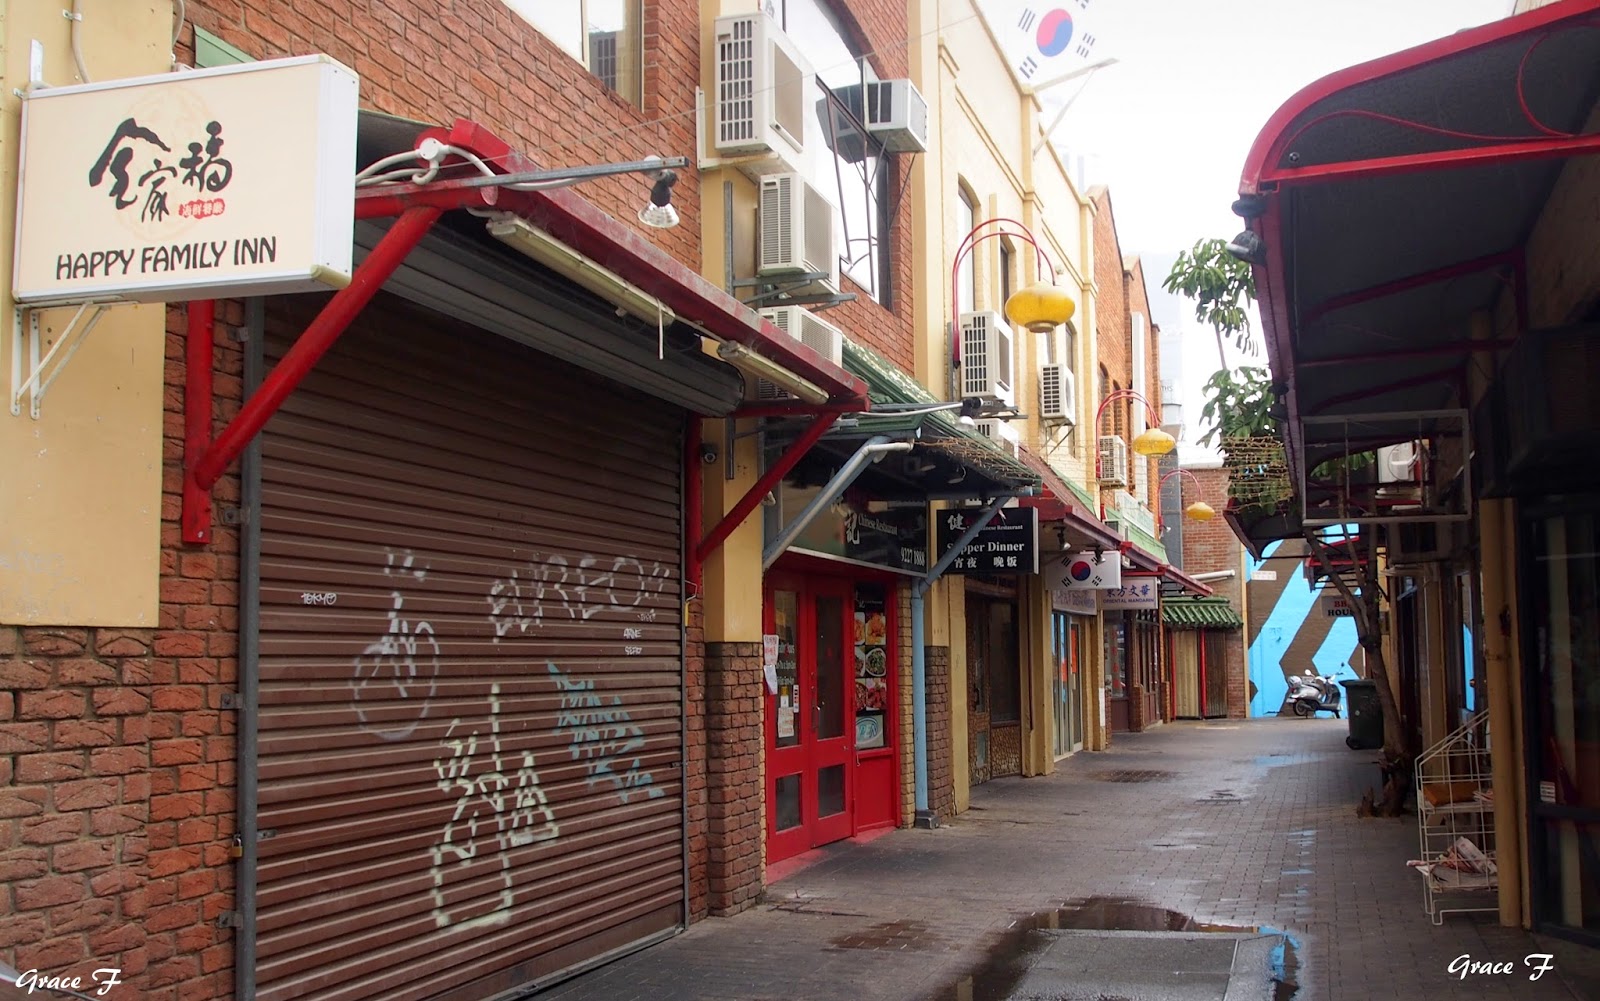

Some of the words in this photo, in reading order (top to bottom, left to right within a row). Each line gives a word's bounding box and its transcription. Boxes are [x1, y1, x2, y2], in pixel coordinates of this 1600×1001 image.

[56, 248, 135, 280] HAPPY
[141, 241, 227, 276] FAMILY
[233, 236, 277, 266] INN
[946, 542, 986, 555] Spper
[987, 541, 1025, 552] Dinner
[1334, 600, 1350, 608] BB
[1327, 608, 1352, 616] HOU
